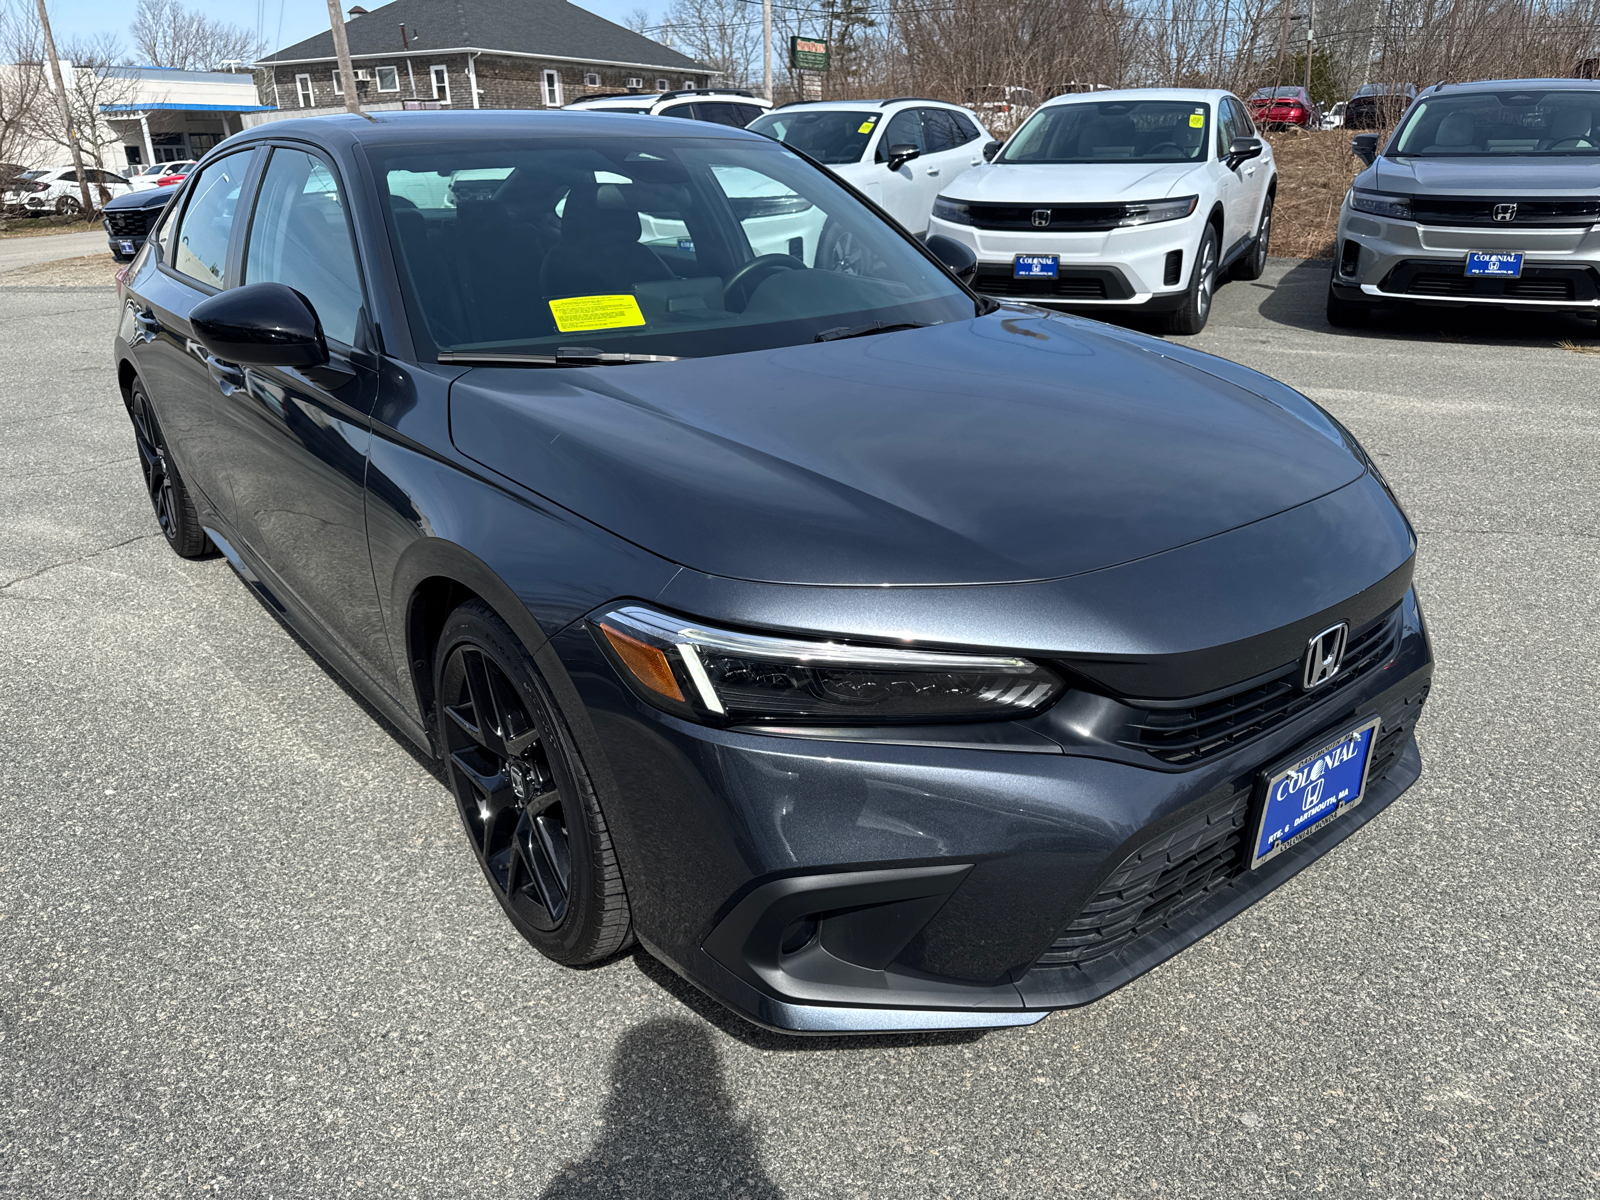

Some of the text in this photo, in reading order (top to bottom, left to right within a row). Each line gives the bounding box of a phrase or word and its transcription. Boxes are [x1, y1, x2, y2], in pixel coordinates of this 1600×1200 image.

[1020, 257, 1054, 265] COLONIAL
[1277, 741, 1358, 801] COLONIAL
[1298, 738, 1341, 768] DARTMOUTH
[1268, 788, 1349, 844] RTE. 6 DARTMOUTH, MA
[1280, 811, 1337, 852] COLONIAL HONDA
